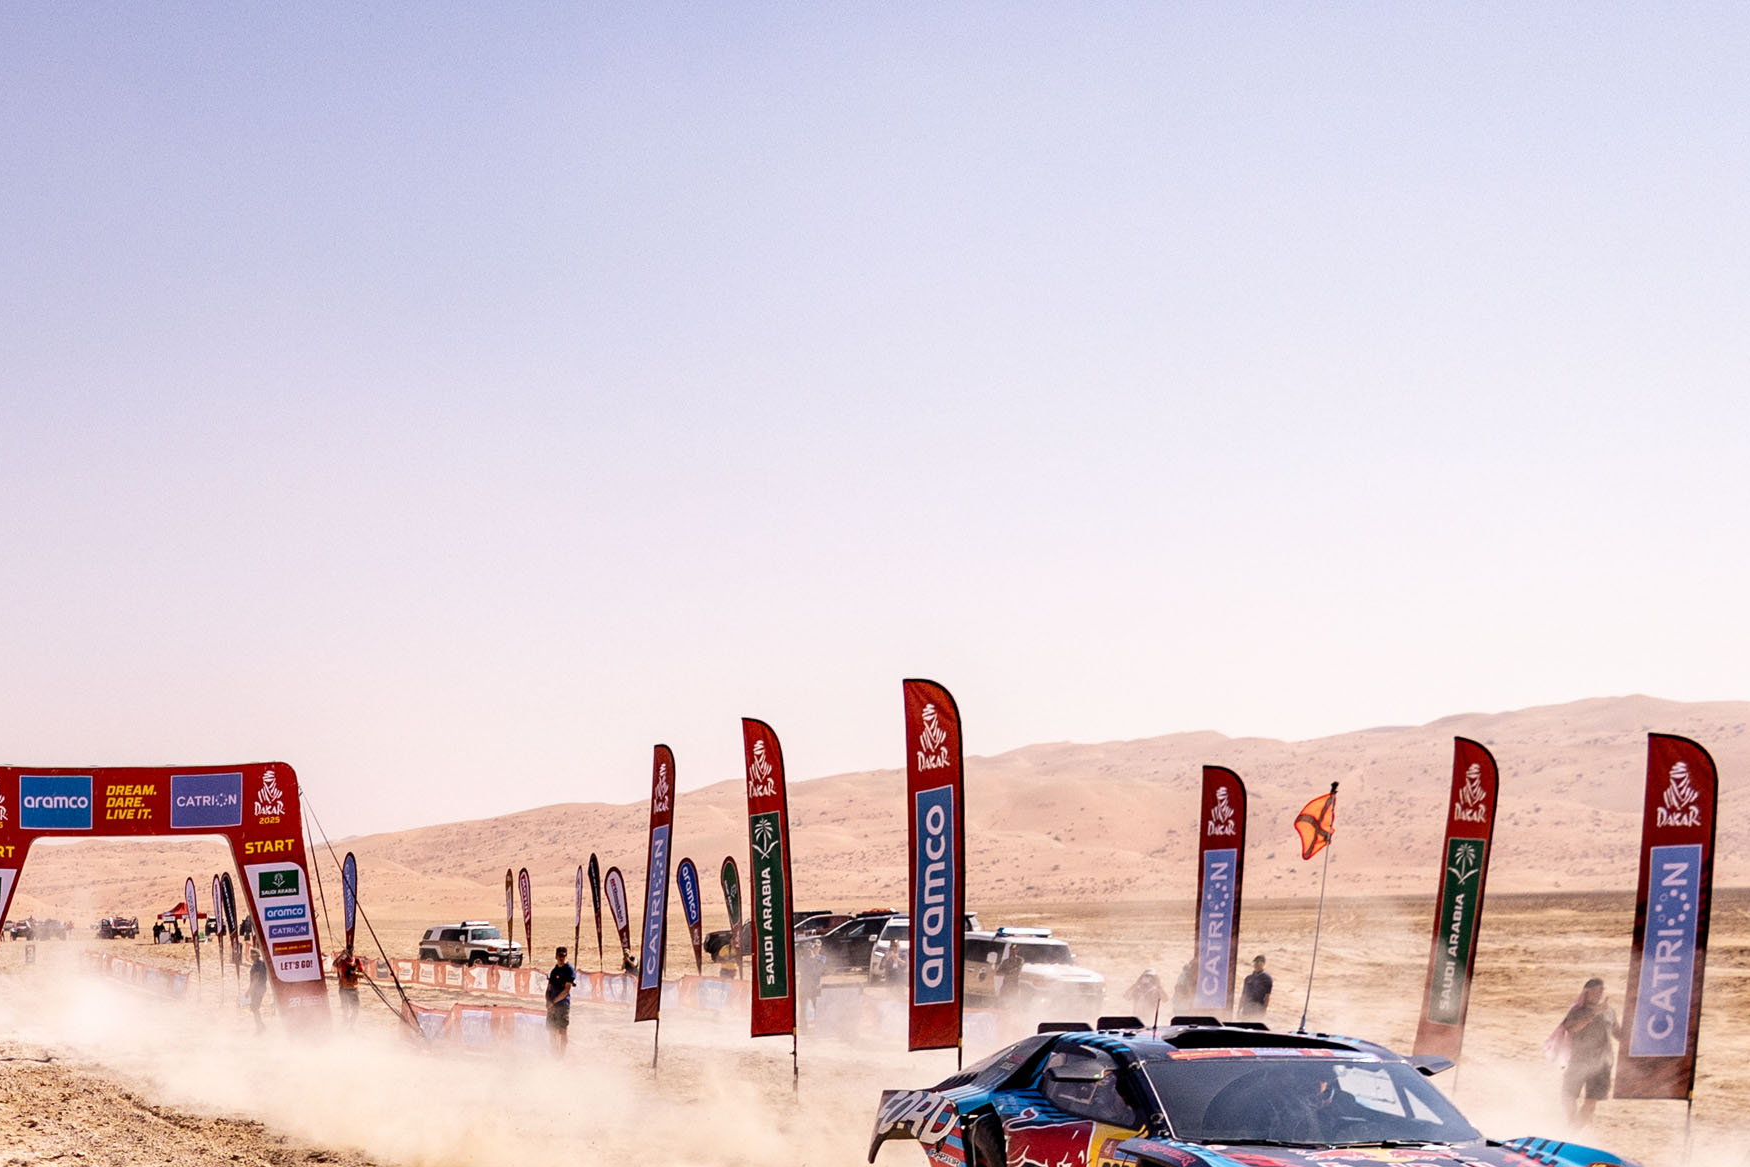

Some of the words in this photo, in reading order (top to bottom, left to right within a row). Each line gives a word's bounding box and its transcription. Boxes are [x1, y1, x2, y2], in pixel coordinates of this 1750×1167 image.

[917, 747, 951, 772] DAKAR
[106, 785, 158, 796] DREAM.
[749, 777, 777, 798] DAKAR
[23, 795, 89, 809] aramco
[106, 796, 146, 808] DARE.
[176, 793, 238, 808] CATRION
[254, 800, 286, 816] DAKAR
[105, 808, 135, 820] LIVE
[136, 808, 153, 820] IT.
[258, 816, 281, 825] 2025
[1453, 802, 1487, 824] DAKAR
[1656, 806, 1701, 827] DAKAR
[1207, 820, 1237, 836] DAKAR
[244, 838, 295, 855] START
[682, 866, 697, 920] aramco
[763, 867, 773, 931] ARABIA
[921, 804, 946, 989] aramco
[267, 907, 304, 918] aramco
[1201, 862, 1229, 996] CATRION
[1445, 893, 1465, 958] ARABIA
[765, 936, 775, 986] SAUDI
[1647, 861, 1690, 1040] CATRION
[280, 960, 300, 971] LET'S
[300, 959, 313, 969] GO!
[1439, 960, 1456, 1012] SAUDI
